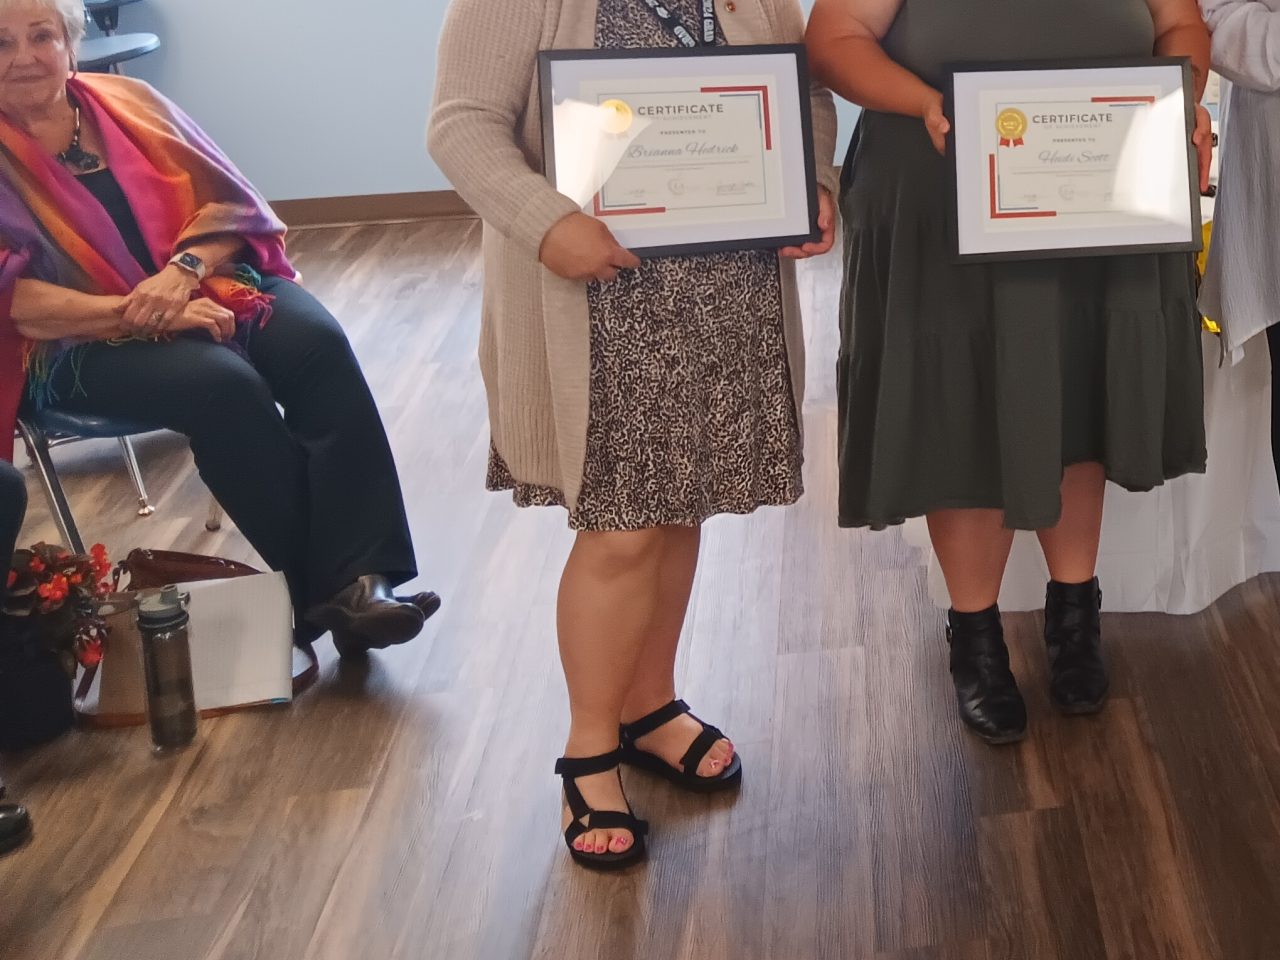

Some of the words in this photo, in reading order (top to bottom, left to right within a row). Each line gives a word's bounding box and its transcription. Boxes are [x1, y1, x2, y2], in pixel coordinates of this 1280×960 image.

[637, 103, 724, 116] CERTIFICATE
[1032, 113, 1113, 124] CERTIFICATE
[627, 144, 683, 159] Brianna
[684, 141, 739, 155] Hedrick
